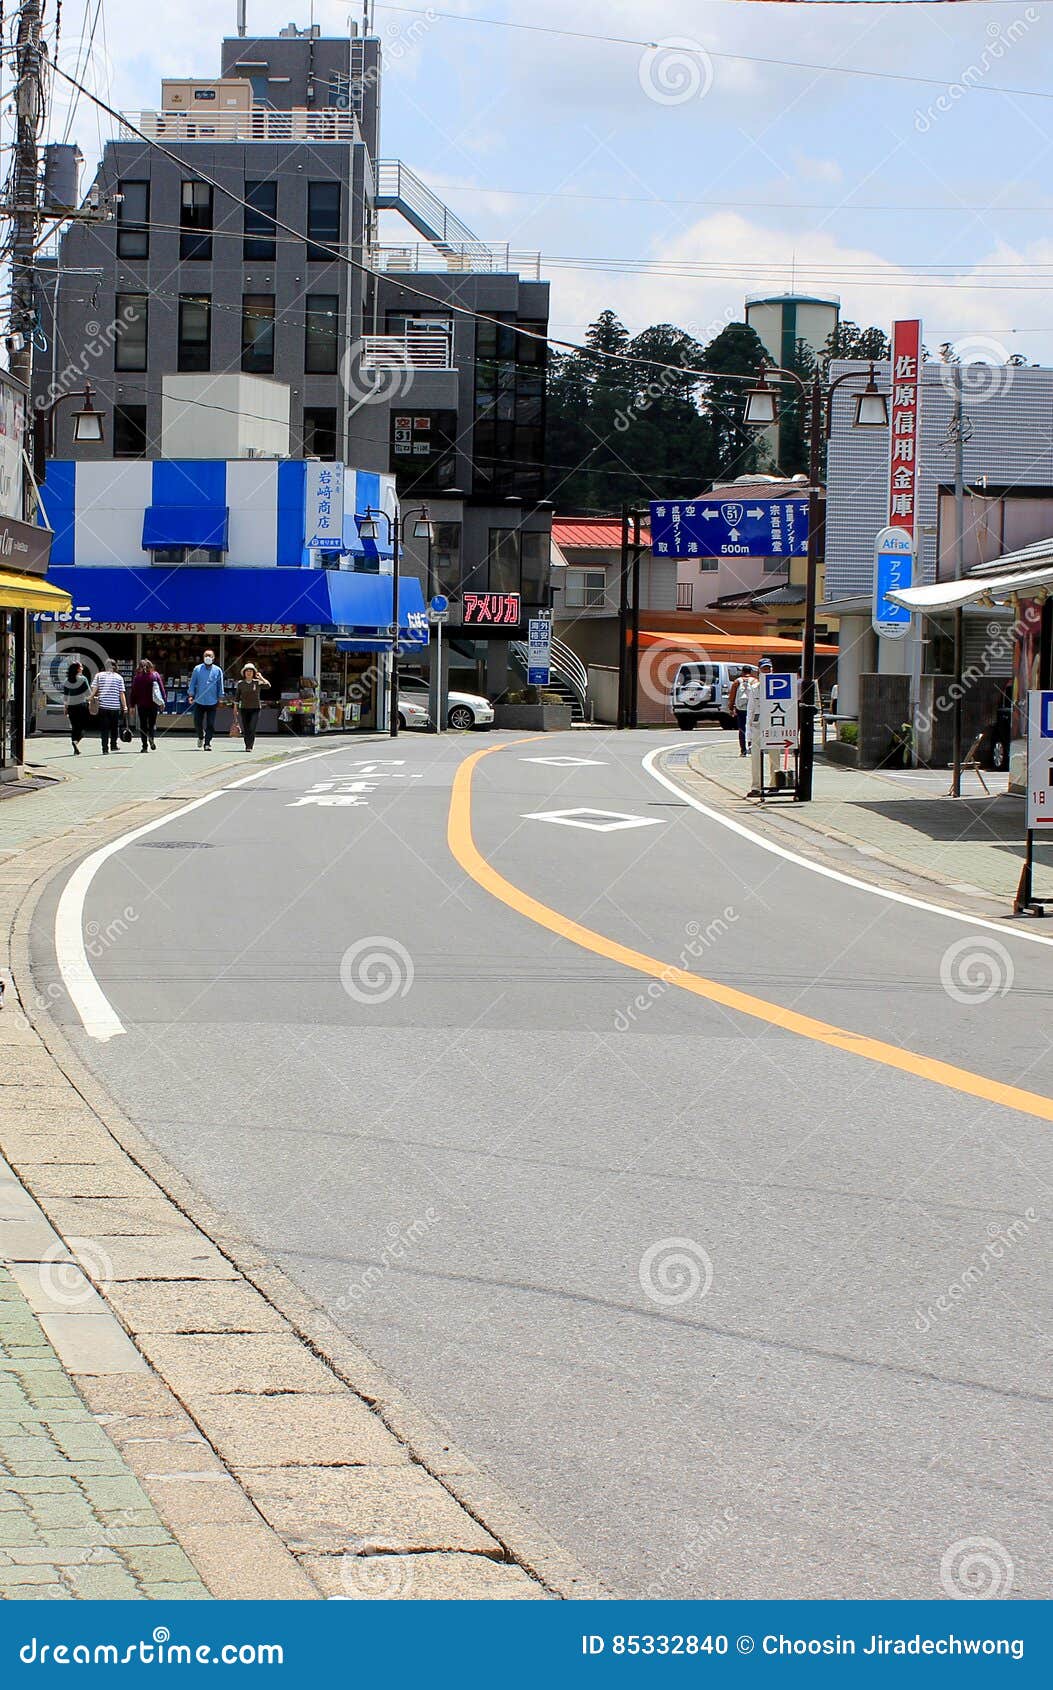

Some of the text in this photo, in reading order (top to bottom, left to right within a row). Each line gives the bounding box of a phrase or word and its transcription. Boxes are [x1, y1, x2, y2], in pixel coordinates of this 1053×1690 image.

[396, 431, 410, 440] 31
[891, 355, 917, 517] 佐原信用金庫
[727, 510, 738, 519] 51
[656, 506, 668, 553] 香取
[686, 506, 698, 553] 空港
[721, 545, 750, 554] 500m
[883, 539, 909, 550] Aflac
[464, 595, 518, 622] アメリカ
[769, 678, 788, 696] P
[770, 702, 786, 726] 入口
